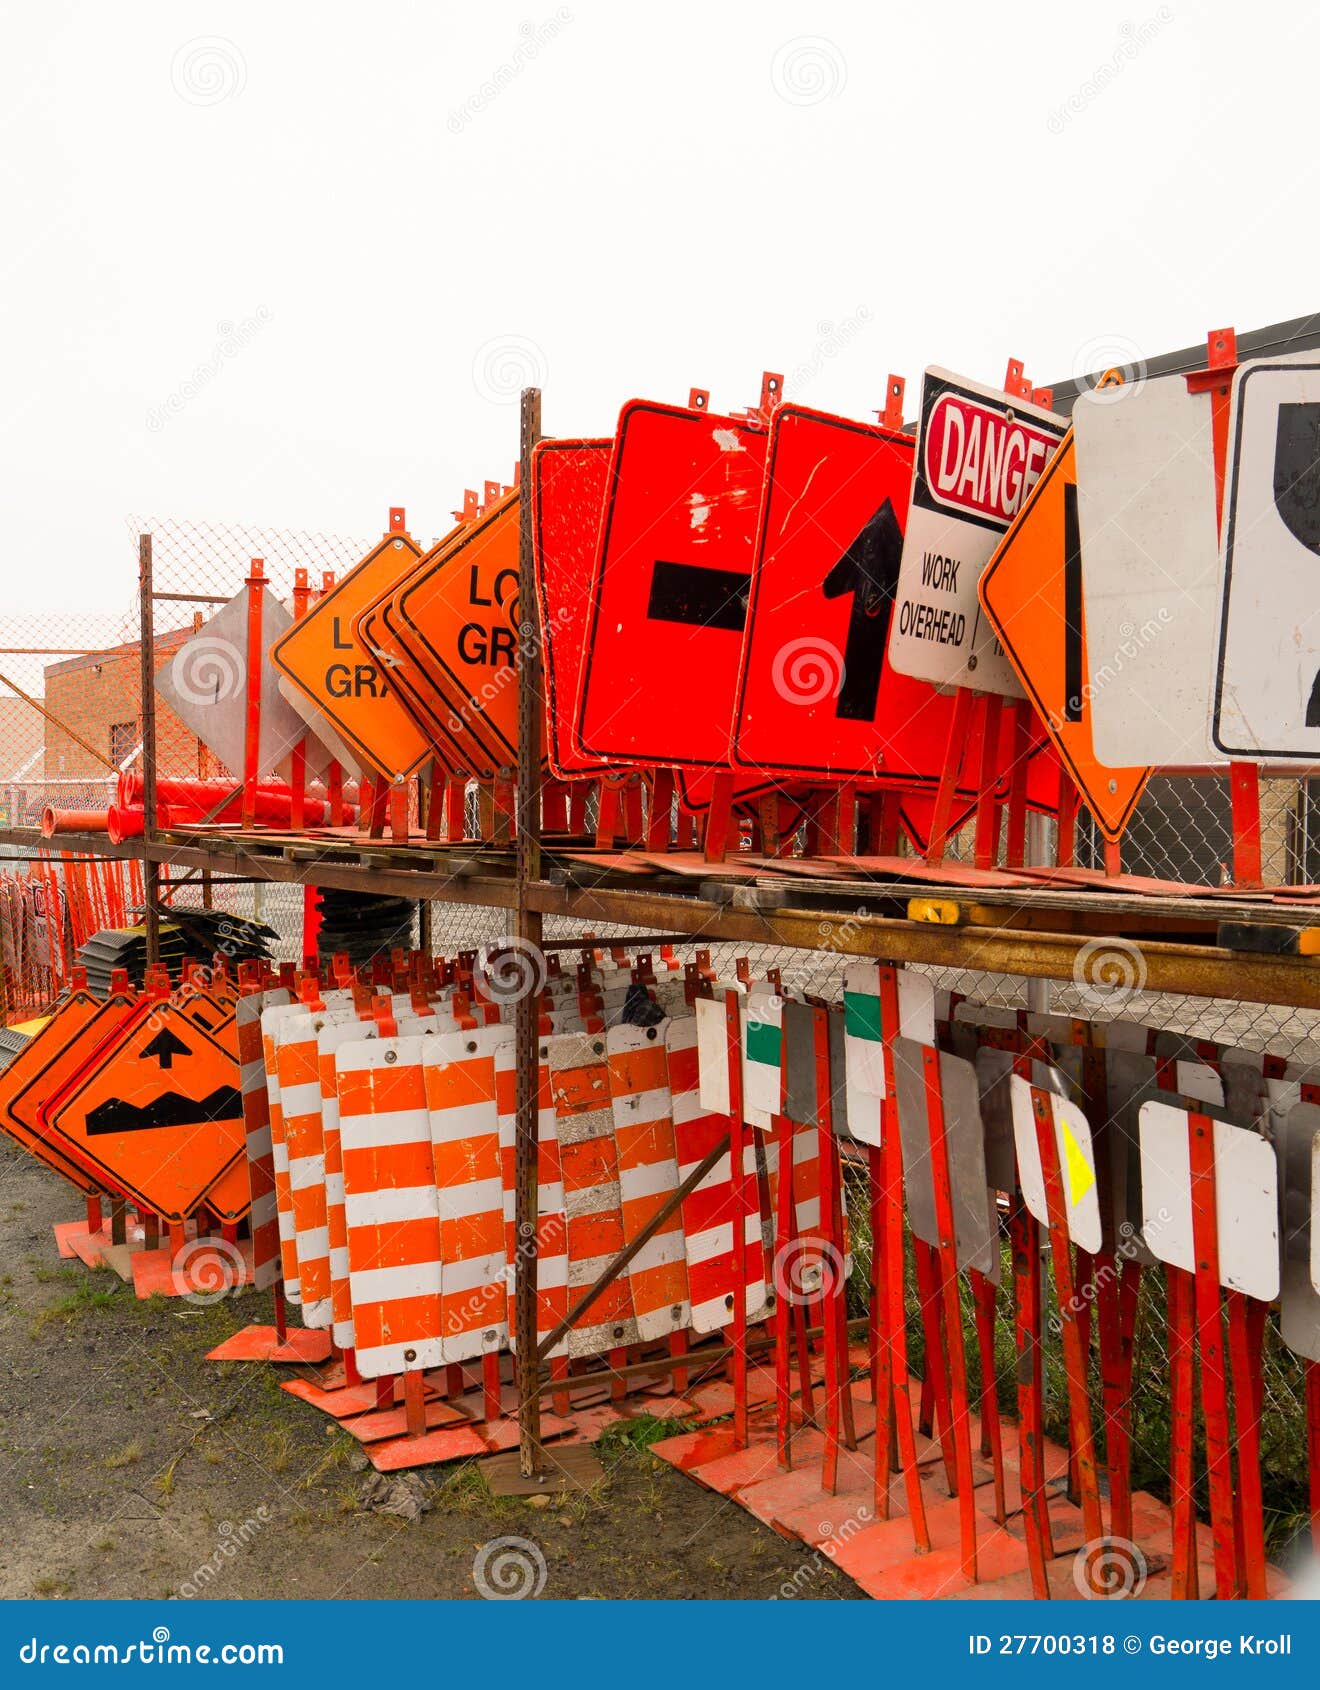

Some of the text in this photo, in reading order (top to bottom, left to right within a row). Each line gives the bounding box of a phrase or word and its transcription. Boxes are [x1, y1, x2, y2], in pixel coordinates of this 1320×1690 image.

[938, 403, 1057, 517] DANGE
[469, 565, 520, 608] LO
[922, 551, 961, 594] WORK
[457, 622, 516, 668] GR
[899, 600, 966, 647] OVERHEAD
